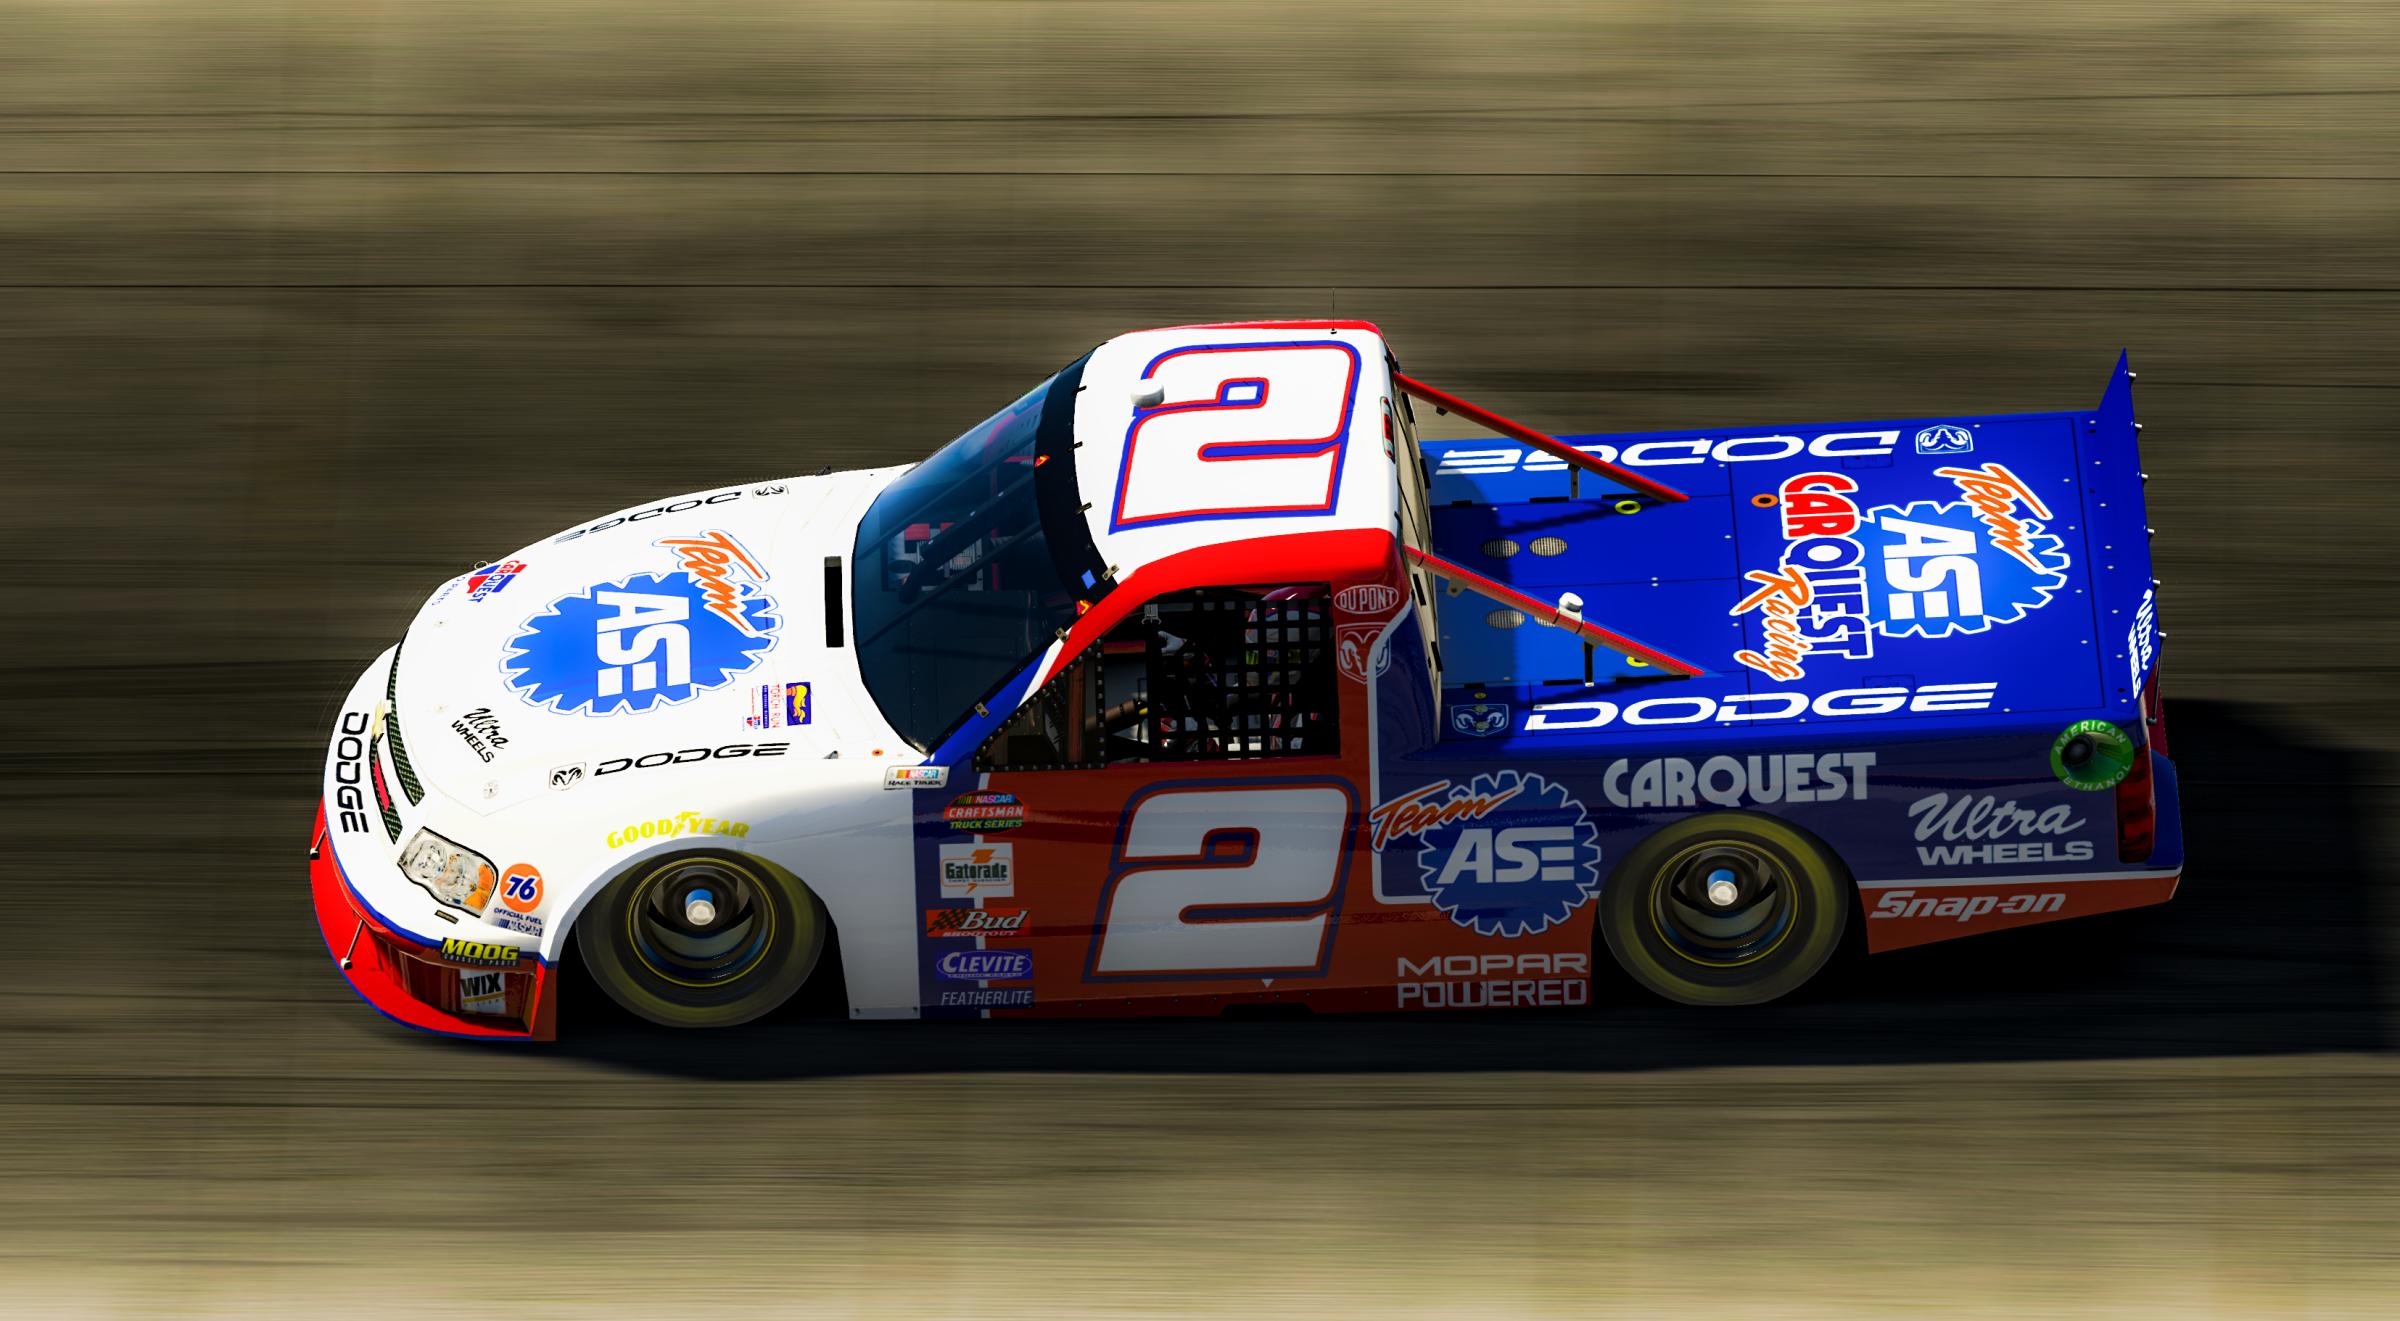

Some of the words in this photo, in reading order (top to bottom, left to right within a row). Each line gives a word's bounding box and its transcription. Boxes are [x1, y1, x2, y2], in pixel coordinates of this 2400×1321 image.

[1108, 340, 1362, 535] 2
[1435, 431, 1900, 475] DODGE
[553, 491, 742, 544] DODGE
[1936, 463, 2050, 571] Team
[656, 530, 764, 633] Team
[1781, 473, 1872, 658] CARQUEST
[1880, 515, 1985, 621] ASE
[1732, 566, 1812, 680] Racing
[596, 589, 691, 697] ASE
[1525, 682, 1999, 733] DODGE
[451, 719, 495, 763] WHEELS
[463, 707, 510, 750] Ultra
[2054, 720, 2127, 756] AMERICAN
[335, 711, 369, 833] DODGE
[594, 742, 790, 776] DODGE
[2063, 763, 2132, 792] ETHANOL
[975, 794, 1014, 804] NASCAR
[1603, 751, 1877, 808] CARQUEST
[948, 806, 1024, 819] CRAFTSMAN
[949, 820, 983, 830] TRUCK
[983, 818, 1023, 829] SERIES
[1370, 779, 1527, 851] Team
[1908, 791, 2089, 844] Ultra
[945, 862, 1008, 880] Gatorade
[1436, 825, 1577, 885] ASE
[1915, 839, 2095, 867] WHEELS
[505, 876, 537, 901] 76
[1082, 775, 1362, 985] 2
[493, 906, 524, 921] OFFICIAL
[525, 914, 543, 925] FUEL
[958, 909, 1030, 930] Bud
[1868, 888, 2067, 923] Snap-on
[441, 938, 521, 961] MOOG
[942, 951, 1026, 974] CLEVITE
[1397, 953, 1588, 978] MOPAR
[461, 973, 502, 997] WIX
[941, 989, 1033, 1006] FEATHERLITE
[1398, 978, 1588, 1009] POWERED
